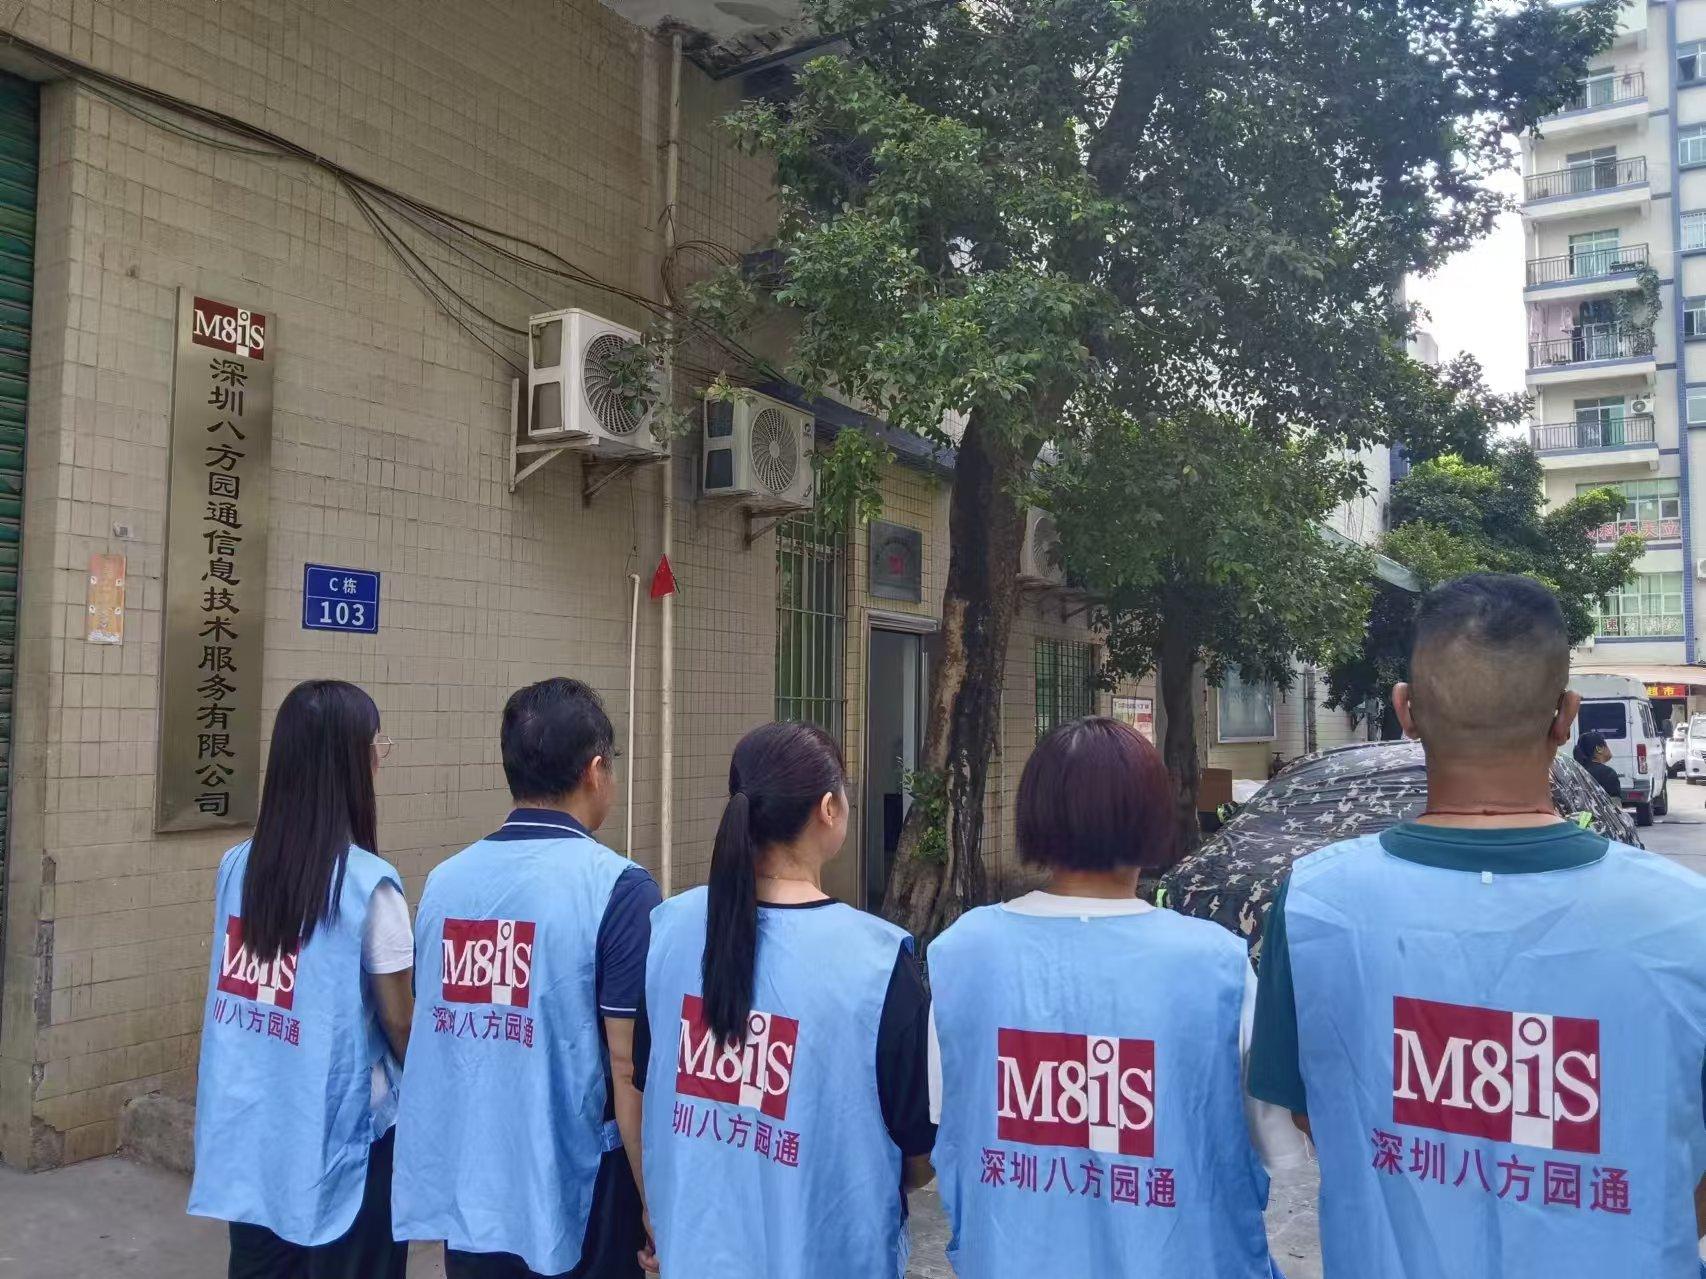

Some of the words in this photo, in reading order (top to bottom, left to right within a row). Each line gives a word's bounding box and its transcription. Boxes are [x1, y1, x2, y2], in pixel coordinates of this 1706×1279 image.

[194, 358, 248, 817] 深圳八方园通信息技术服务有限公司
[320, 601, 364, 626] 103
[980, 1146, 1176, 1208] 深圳八方园通
[1371, 1127, 1632, 1216] 深圳八方园通
